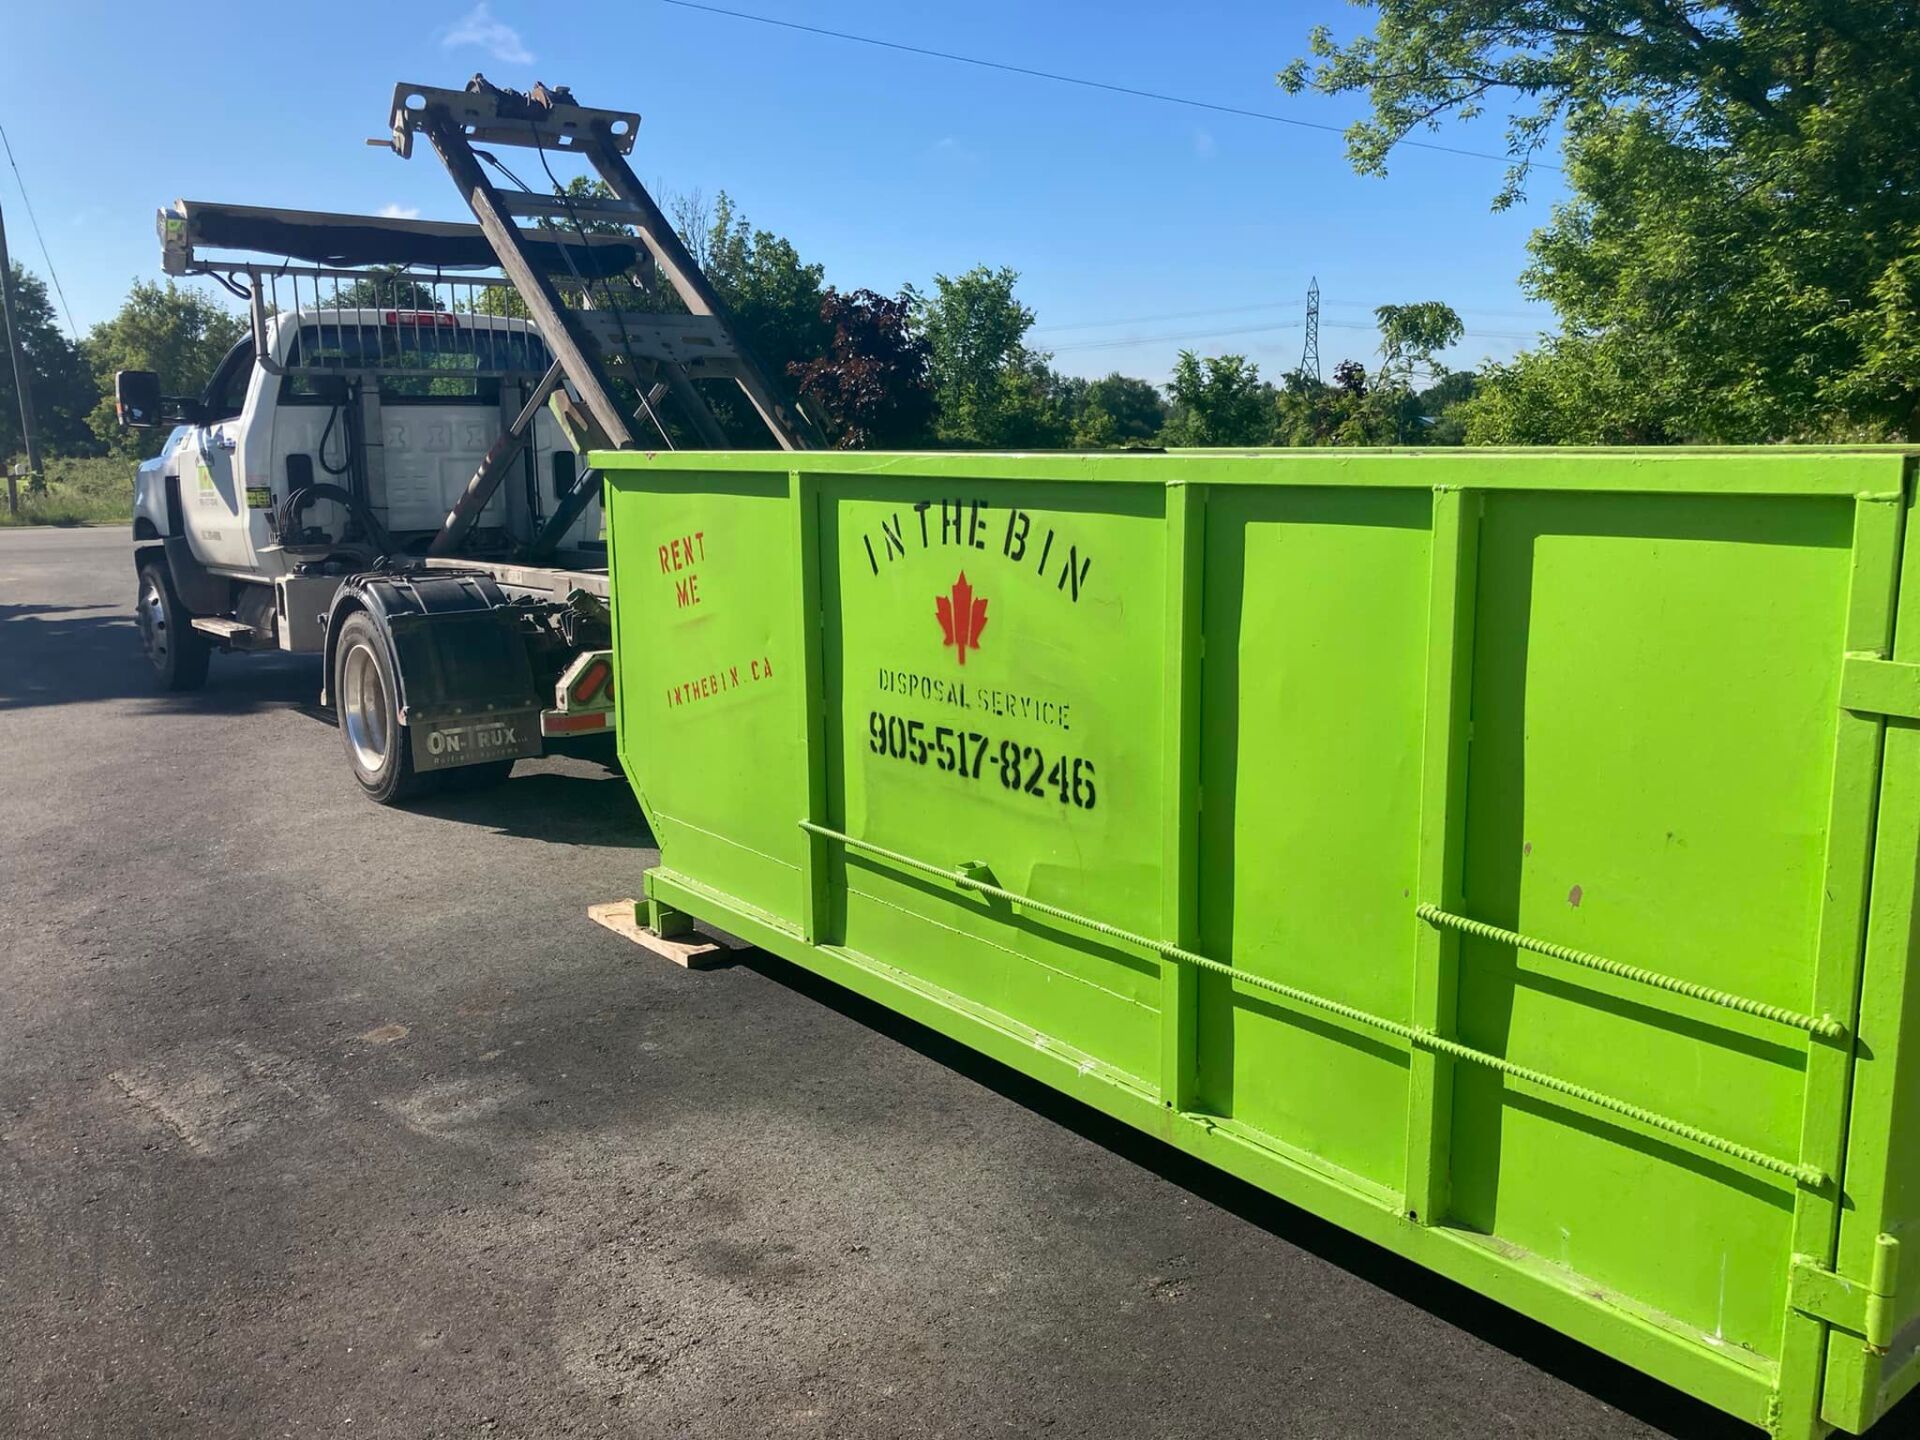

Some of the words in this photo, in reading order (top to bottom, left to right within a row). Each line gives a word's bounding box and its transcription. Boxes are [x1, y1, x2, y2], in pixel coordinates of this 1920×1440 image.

[658, 531, 706, 575] RENT
[675, 574, 702, 609] ME
[879, 668, 970, 710] DISPOSAL
[977, 689, 1070, 730] SERVICE
[869, 711, 1097, 811] 905-517-8246
